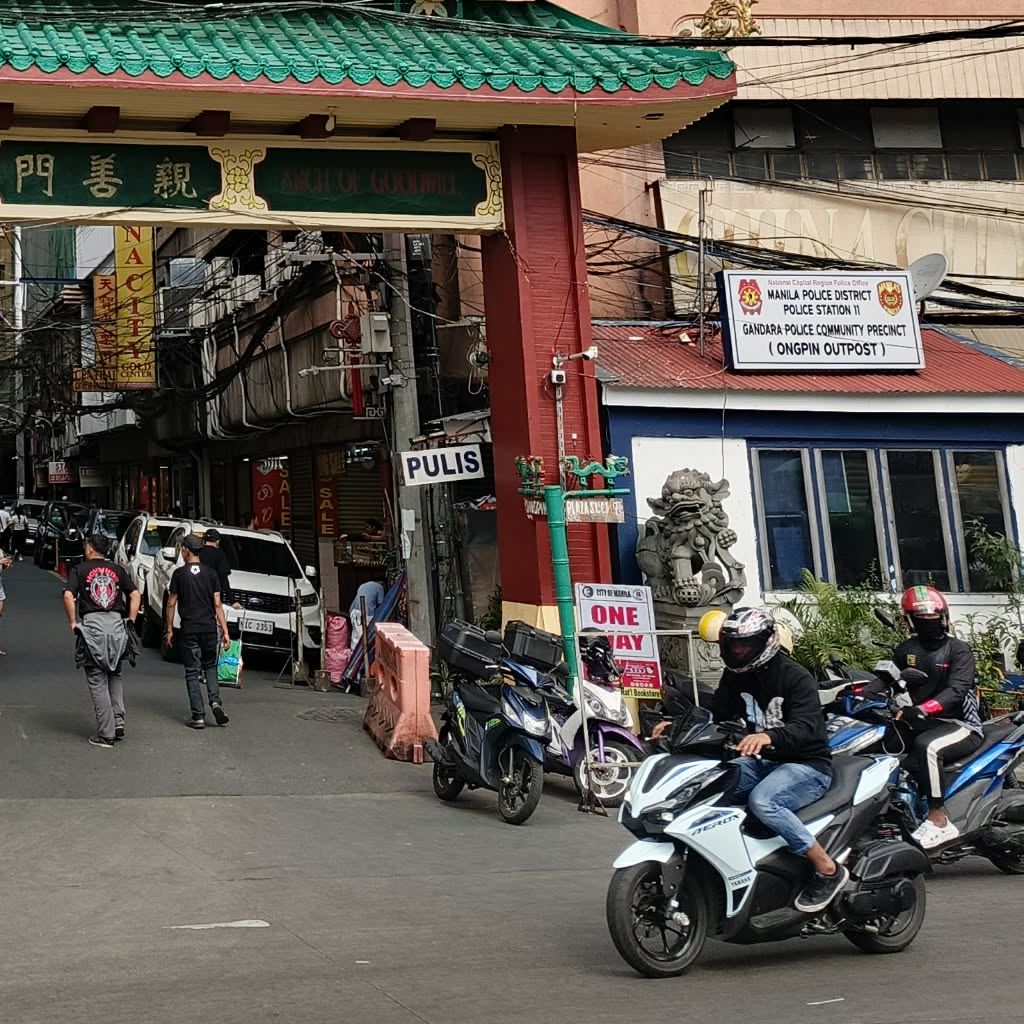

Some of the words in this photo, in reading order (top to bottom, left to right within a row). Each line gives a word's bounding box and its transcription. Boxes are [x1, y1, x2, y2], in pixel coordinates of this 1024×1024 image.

[767, 289, 800, 301] MANILA
[802, 289, 833, 301] POLICE
[835, 290, 872, 301] DISTRICT
[783, 304, 814, 316] POLICE
[816, 304, 851, 316] STATION
[853, 304, 861, 316] 11
[742, 323, 783, 336] GANDARA
[785, 324, 814, 336] POLICE
[816, 324, 864, 336] COMMUNITY
[867, 324, 907, 337] PRECINCT
[777, 342, 821, 356] ONGPIN
[825, 342, 878, 356] OUTPOST
[121, 362, 151, 371] GOLD
[406, 450, 480, 479] PULIS
[591, 604, 639, 626] ONE
